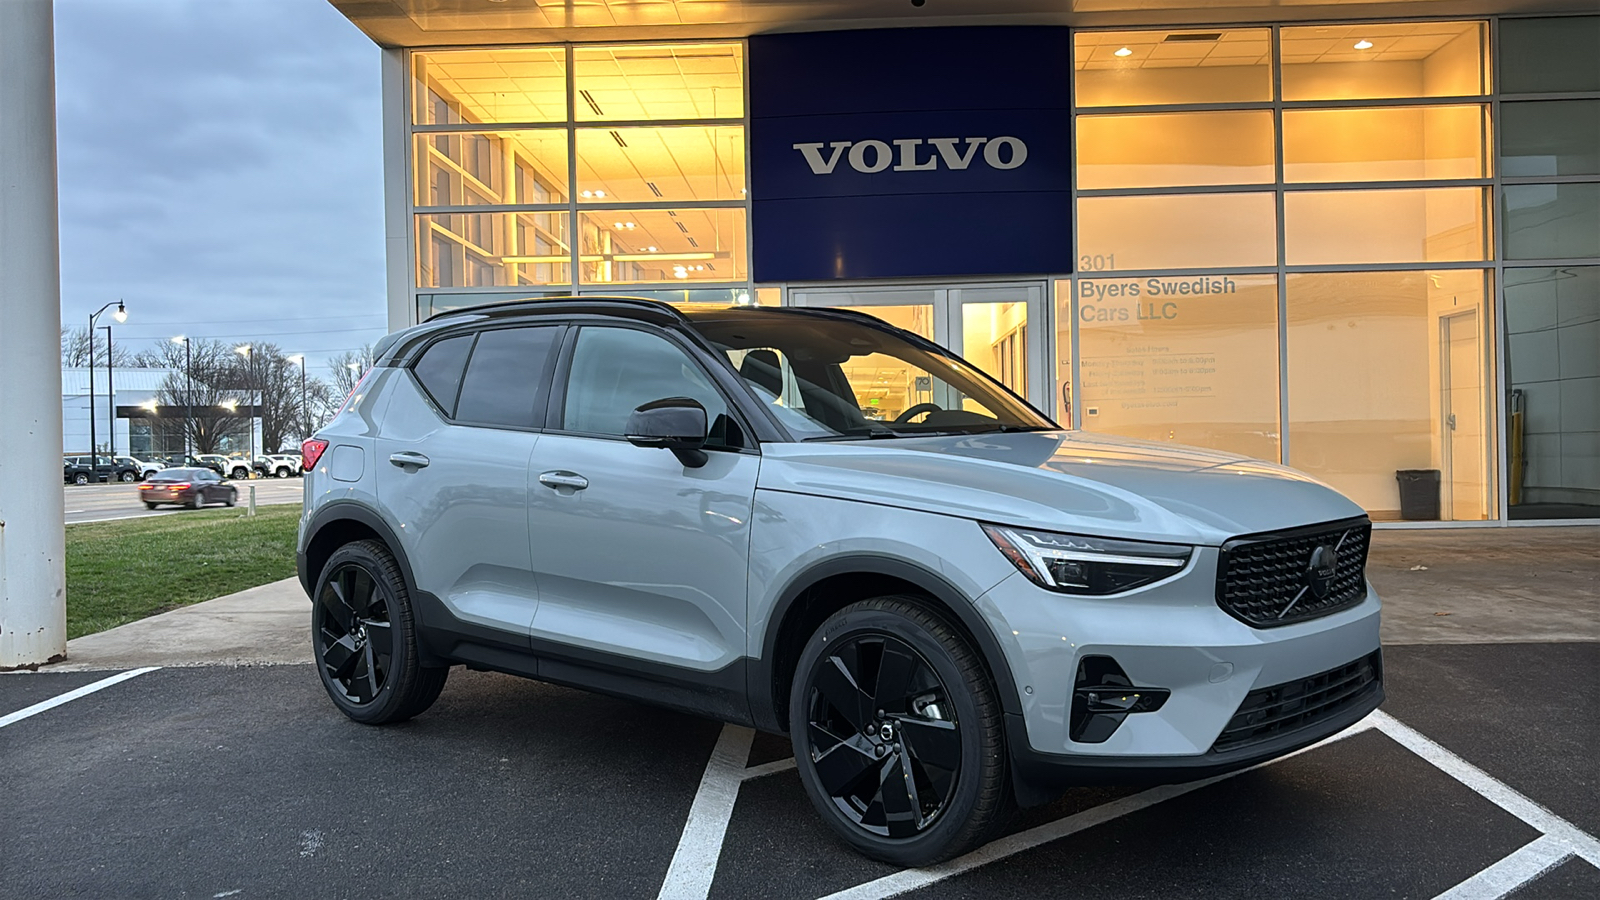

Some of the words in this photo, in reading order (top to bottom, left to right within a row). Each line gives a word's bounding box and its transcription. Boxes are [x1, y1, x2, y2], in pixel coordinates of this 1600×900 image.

[793, 136, 1028, 174] VOLVO
[1080, 254, 1115, 271] 301
[1080, 280, 1141, 301] Byers
[1147, 277, 1236, 296] Swedish
[1080, 304, 1130, 322] Cars
[1137, 302, 1178, 320] LLC
